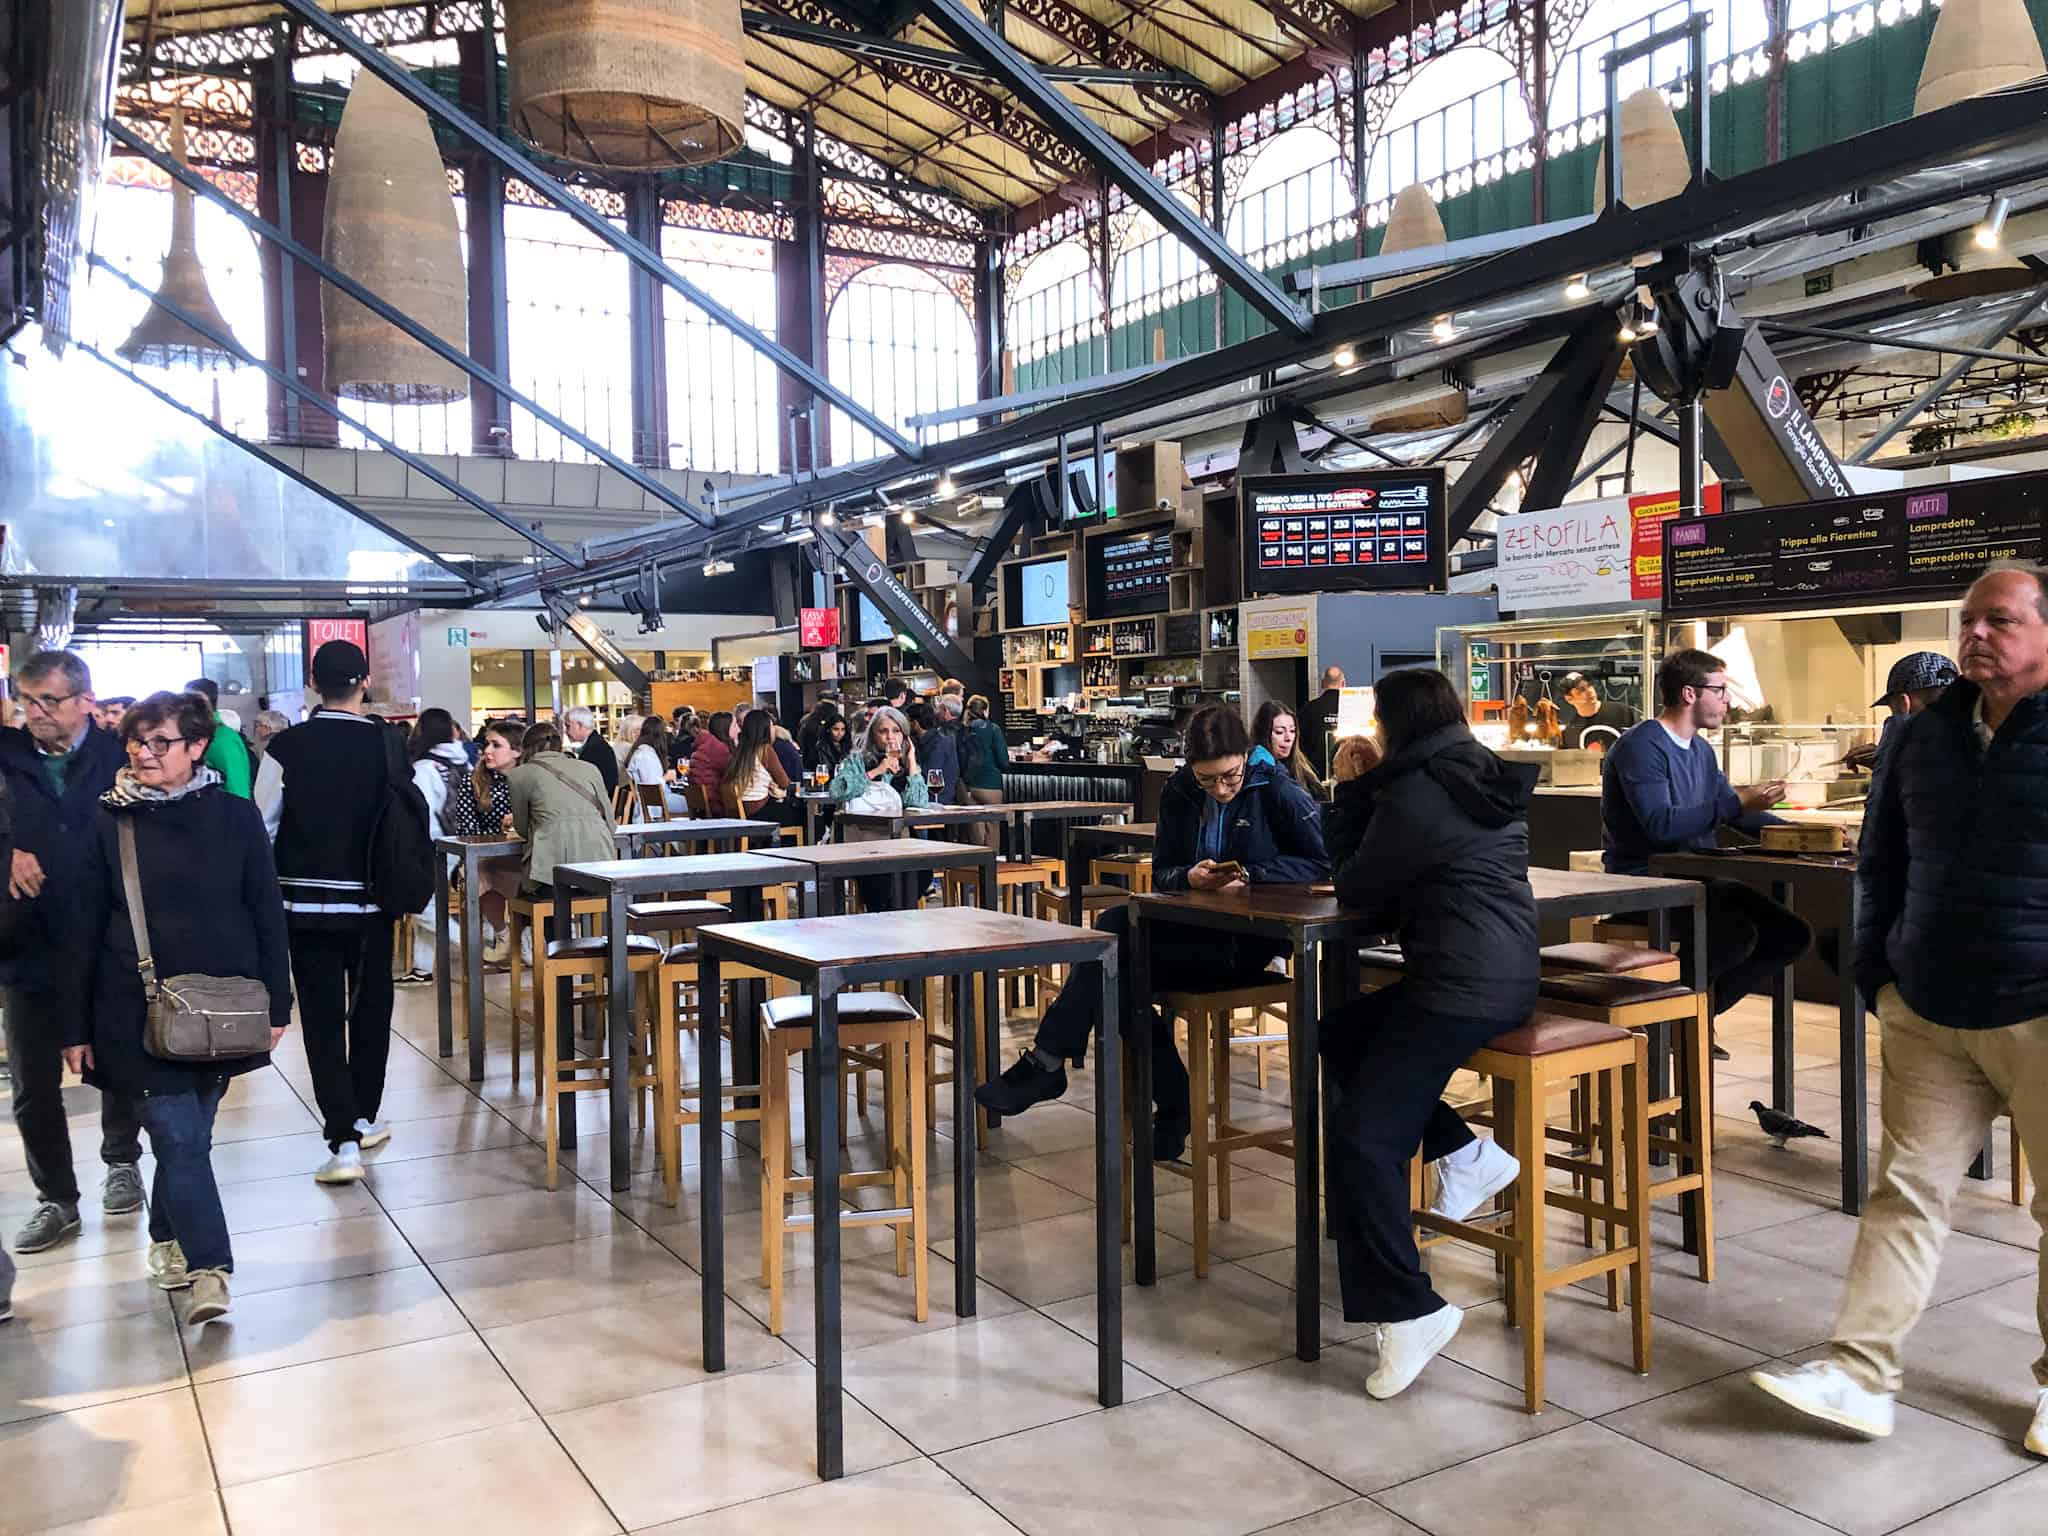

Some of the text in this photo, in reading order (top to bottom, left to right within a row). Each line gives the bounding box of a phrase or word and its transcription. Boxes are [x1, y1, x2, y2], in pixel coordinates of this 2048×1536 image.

[1799, 422, 1849, 497] LAMPREDO
[1806, 457, 1826, 487] Bambi
[1316, 493, 1333, 502] TUO
[1504, 514, 1619, 550] ZEROFILA
[1910, 518, 1976, 533] Lampredotto
[1780, 529, 1878, 548] Trippa alla Fiorentina
[1675, 546, 1725, 559] Lampredotto
[1910, 551, 1975, 566] Lampredotto
[1977, 549, 1988, 559] al
[1675, 573, 1755, 587] Lampredotto al sugo
[311, 621, 365, 640] TOILET
